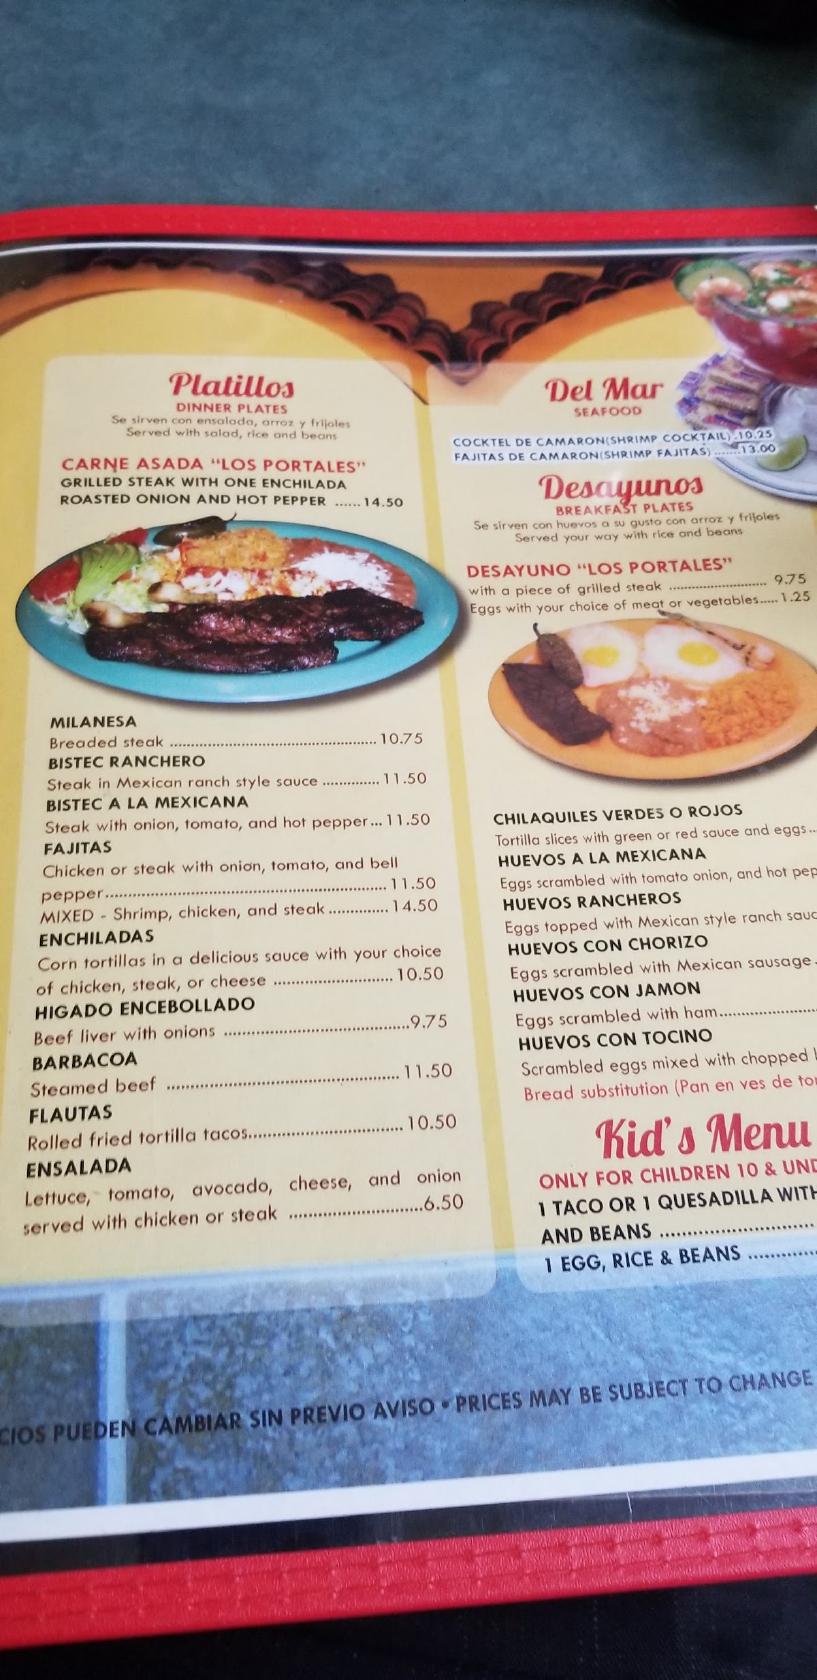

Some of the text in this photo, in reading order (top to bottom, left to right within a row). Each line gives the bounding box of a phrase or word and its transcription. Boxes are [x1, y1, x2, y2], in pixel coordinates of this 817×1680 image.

[168, 372, 295, 399] Platillos
[544, 376, 664, 403] Del Mar
[175, 402, 288, 415] DINNER PLATES
[573, 405, 643, 418] SEAFOOD
[125, 426, 337, 441] Served with salad, rice and beans
[61, 457, 129, 474] CARNE
[135, 457, 204, 471] ASADA
[454, 452, 505, 462] FAJITAS
[508, 452, 525, 462] DE
[60, 476, 347, 490] GRILLED STEAK WITH ONE ENCHILADA
[538, 474, 704, 507] Desayunos
[60, 493, 131, 506] ROASTED
[135, 493, 191, 505] ONION
[196, 493, 231, 505] AND
[236, 494, 269, 505] HOT
[273, 495, 327, 507] PEPPER
[555, 501, 694, 517] BREAKFAST PLATES
[514, 527, 743, 544] Served your way with rice and beans
[466, 563, 571, 579] DESAYUNO
[468, 584, 497, 597] with
[501, 587, 510, 597] a
[515, 585, 553, 599] piece
[556, 583, 571, 595] of
[577, 581, 621, 597] grilled
[625, 580, 662, 593] steak
[49, 715, 137, 729] MILANESA
[49, 735, 118, 750] Breaded
[123, 735, 164, 748] steak
[48, 755, 206, 770] BISTEC RANCHERO
[47, 777, 92, 792] Steak
[98, 777, 111, 789] in
[116, 776, 183, 789] Mexican
[187, 775, 230, 789] ranch
[235, 775, 271, 791] style
[275, 777, 319, 787] sauce
[46, 795, 249, 813] BISTEC A LA MEXICANA
[493, 803, 743, 826] CHILAQUILES VERDES O ROJOS
[494, 823, 771, 847] Tortilla slices with green or red sauce and
[43, 840, 113, 856] FAJITAS
[497, 847, 707, 868] HUEVOS A LA MEXICANA
[502, 891, 682, 912] HUEVOS RANCHEROS
[39, 909, 95, 925] MIXED
[113, 907, 173, 923] Shrimp,
[178, 903, 241, 920] chicken,
[247, 901, 278, 917] and
[283, 901, 325, 916] steak
[39, 929, 155, 948] ENCHILADAS
[507, 934, 709, 957] HUEVOS CON CHORIZO
[37, 944, 442, 972] Corn tortillas in a delicious sauce with your choice
[512, 981, 701, 1003] HUEVOS CON JAMON
[35, 996, 256, 1021] HIGADO ENCEBOLLADO
[515, 1013, 554, 1030] Eggs
[559, 1007, 641, 1026] scrambled
[646, 1005, 679, 1021] with
[518, 1028, 713, 1051] HUEVOS CON TOCINO
[32, 1051, 138, 1072] BARBACOA
[30, 1078, 109, 1099] Steamed
[115, 1075, 157, 1093] beef
[29, 1104, 113, 1125] FLAUTAS
[705, 1112, 813, 1154] Menu
[26, 1157, 132, 1179] ENSALADA
[539, 1161, 777, 1190] ONLY FOR CHILDREN 10 &
[538, 1188, 774, 1217] 1 TACO OR 1 QUESADILLA
[541, 1222, 652, 1245] AND BEANS
[544, 1244, 741, 1274] 1 EGG, RICE & BEANS
[52, 1368, 814, 1444] PUEDEN CAMBIAR SIN PREVIO AVISO PRICES MAY BE SUBJECT TO CHANGE
